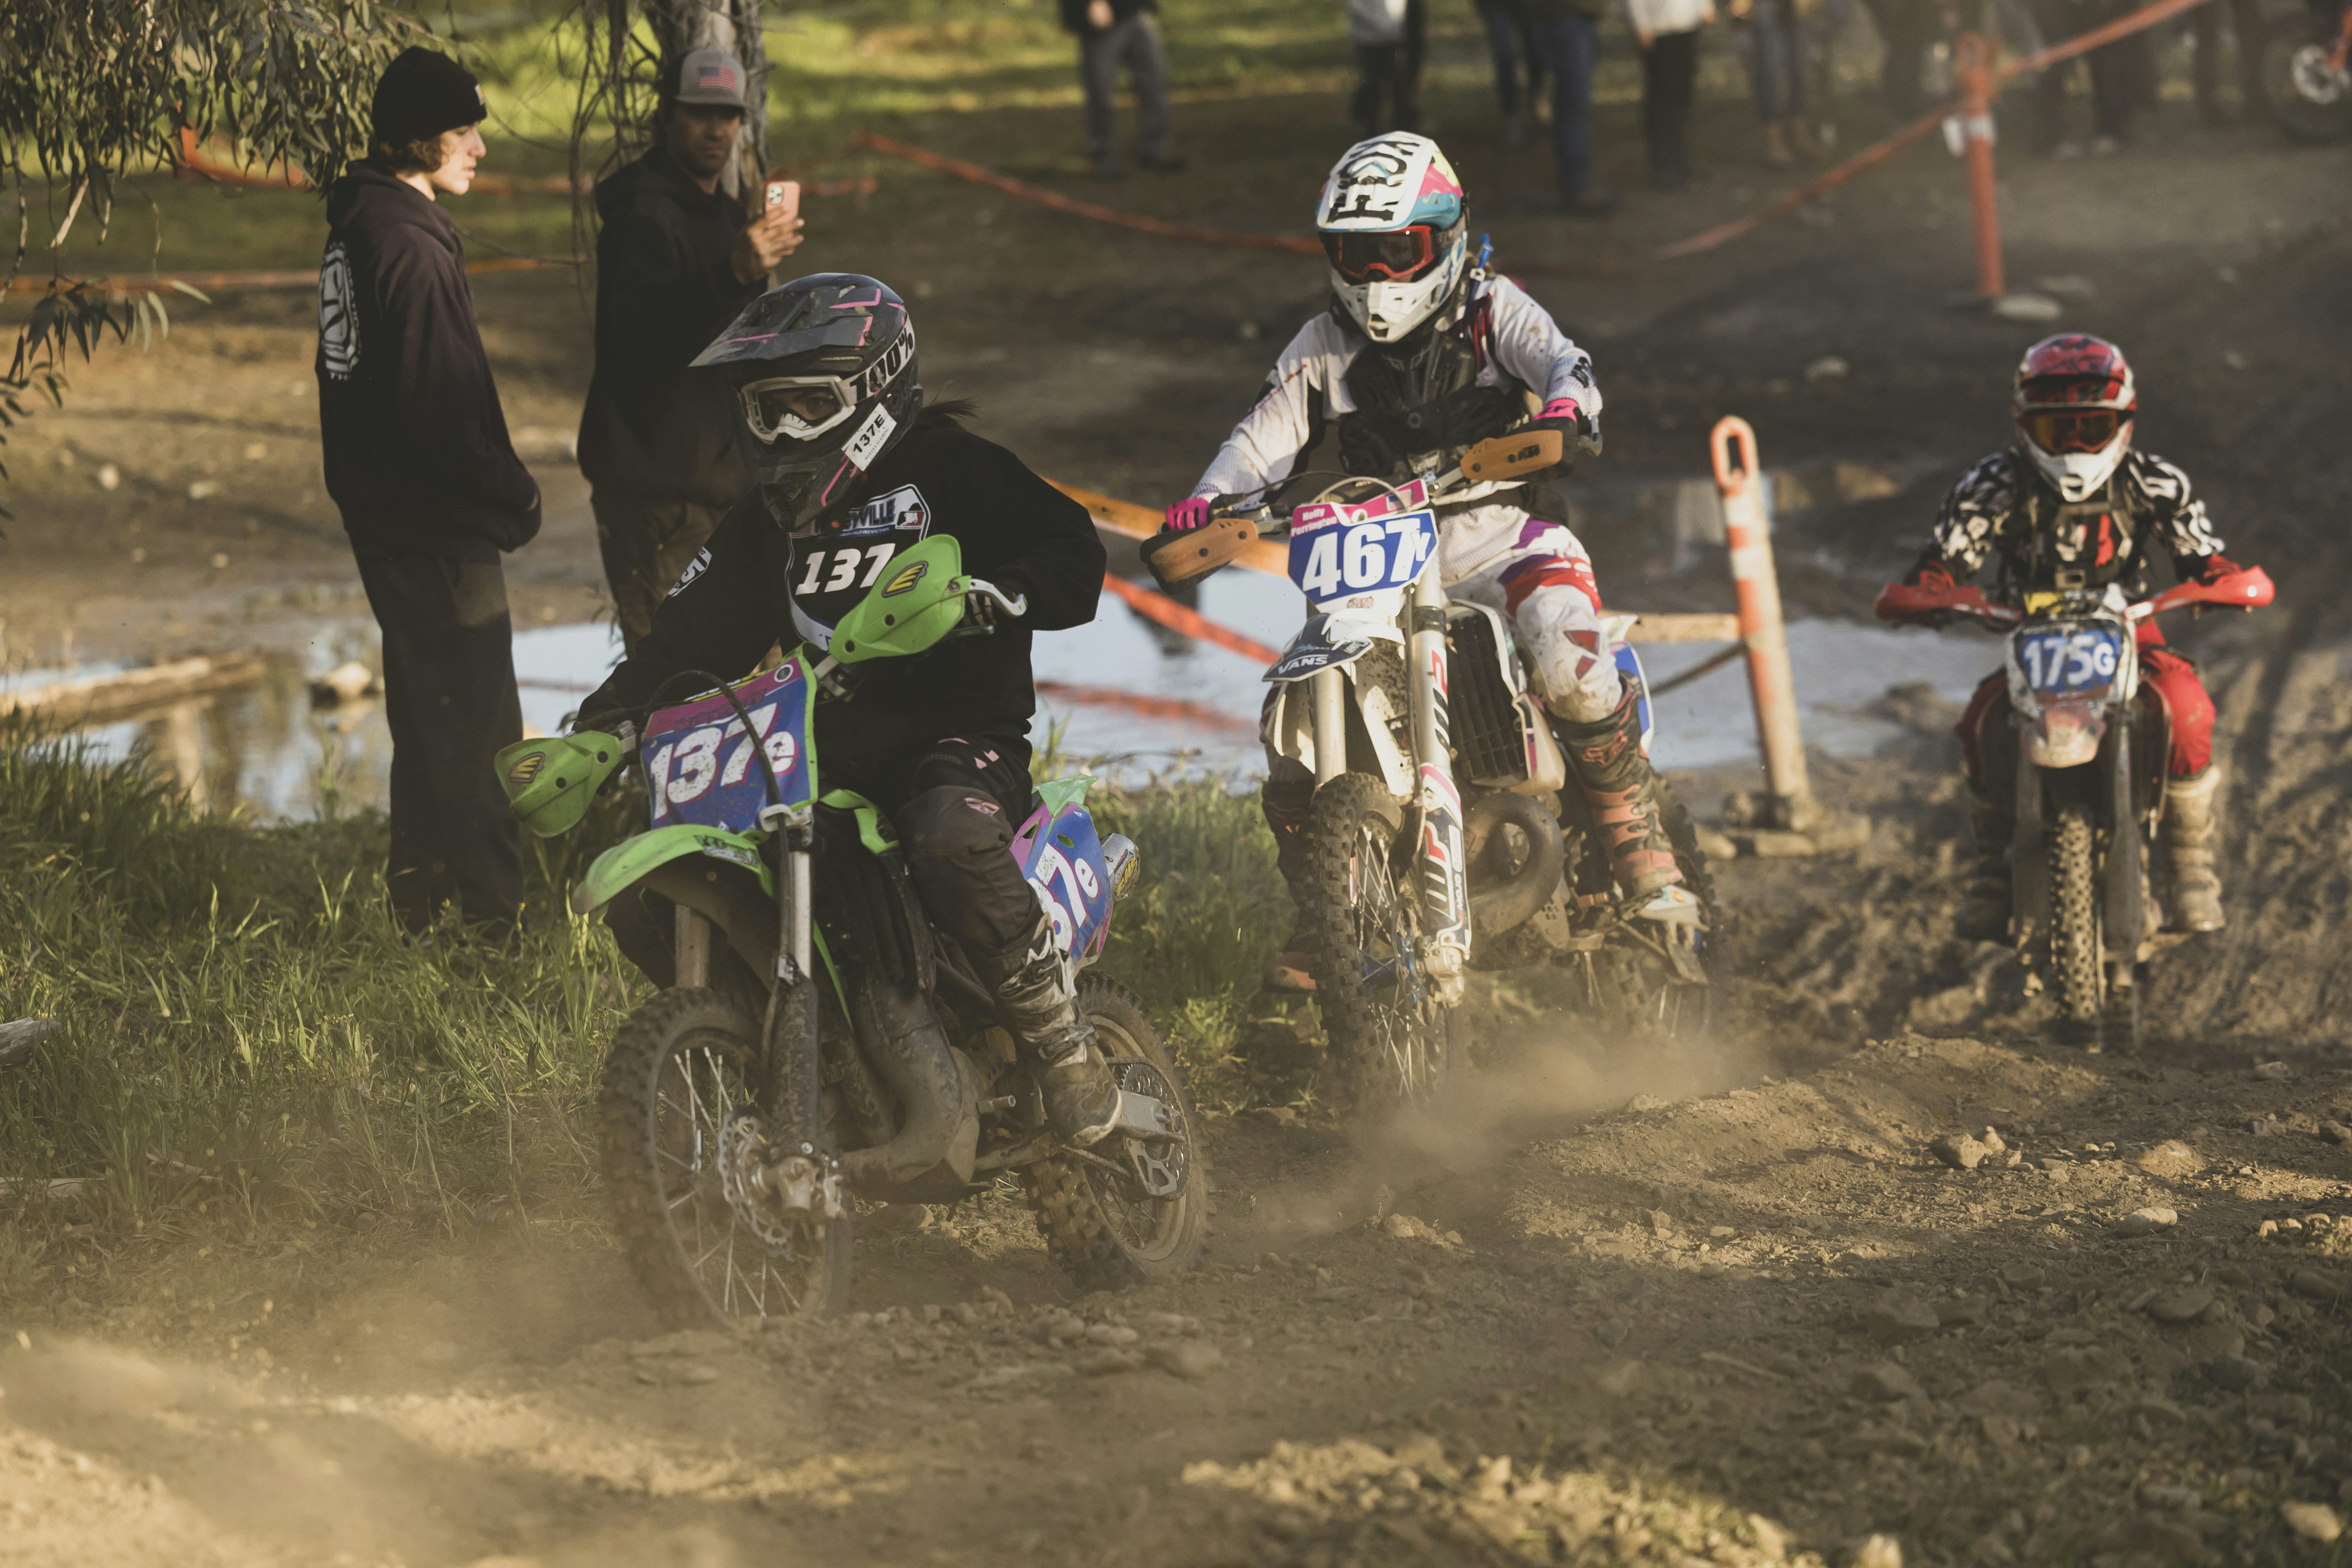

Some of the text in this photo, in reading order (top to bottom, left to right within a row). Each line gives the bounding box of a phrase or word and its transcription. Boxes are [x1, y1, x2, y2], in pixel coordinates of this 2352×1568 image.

[850, 327, 914, 401] 100%
[853, 414, 885, 453] 137E
[796, 543, 896, 596] 137
[1278, 654, 1329, 674] VANS
[1028, 842, 1098, 951] 37e
